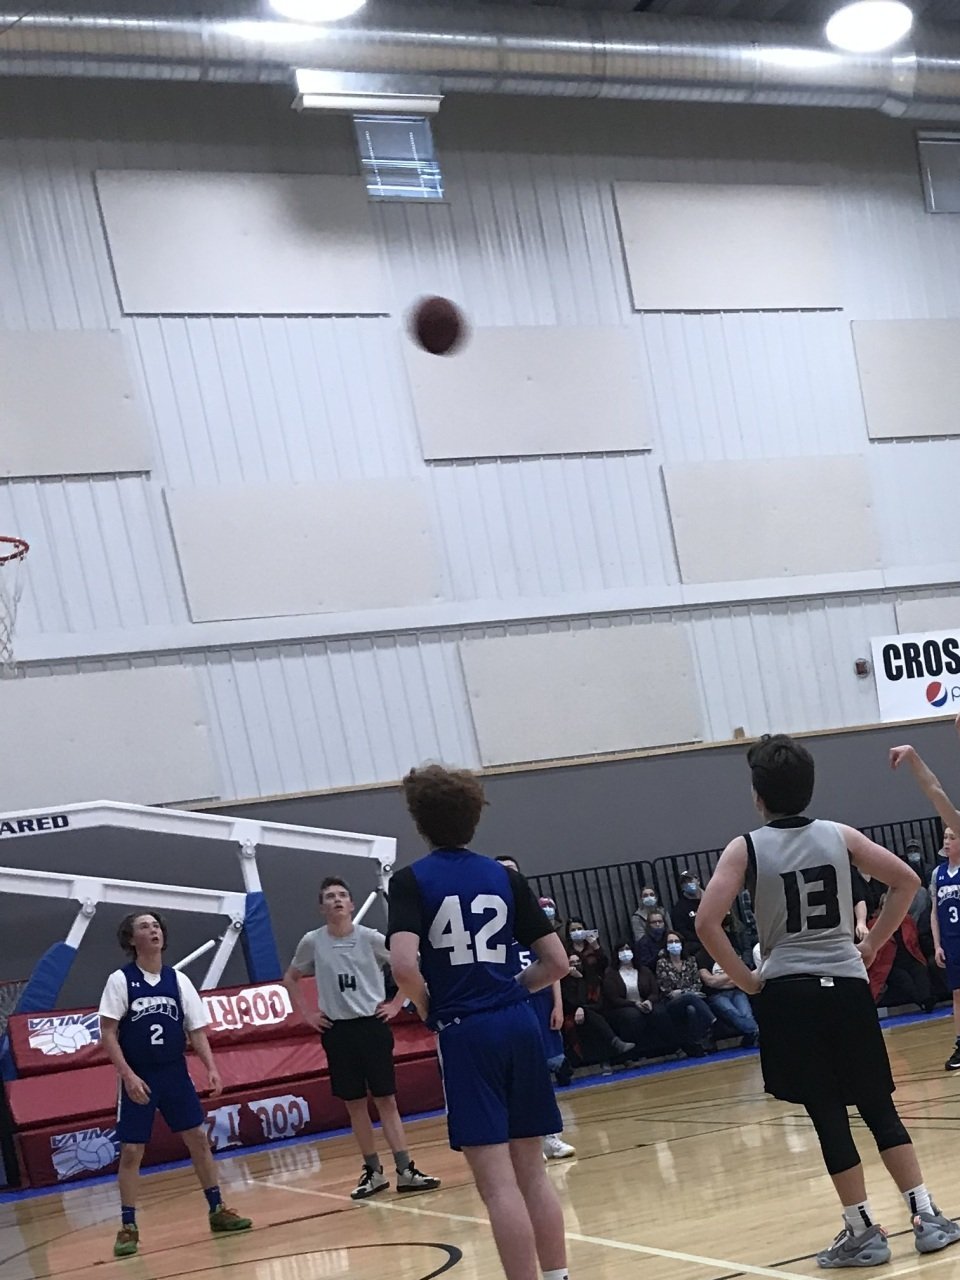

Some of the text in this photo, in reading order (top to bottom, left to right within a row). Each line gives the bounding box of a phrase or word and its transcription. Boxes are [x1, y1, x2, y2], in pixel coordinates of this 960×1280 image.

[0, 815, 70, 836] ARED
[779, 864, 841, 933] 13
[948, 906, 960, 923] 3
[428, 894, 509, 966] 42
[518, 950, 532, 970] 5
[338, 973, 357, 992] 14
[29, 1014, 83, 1030] NLVA
[150, 1023, 164, 1045] 2
[226, 1100, 304, 1144] COUT
[51, 1128, 104, 1147] NLVA
